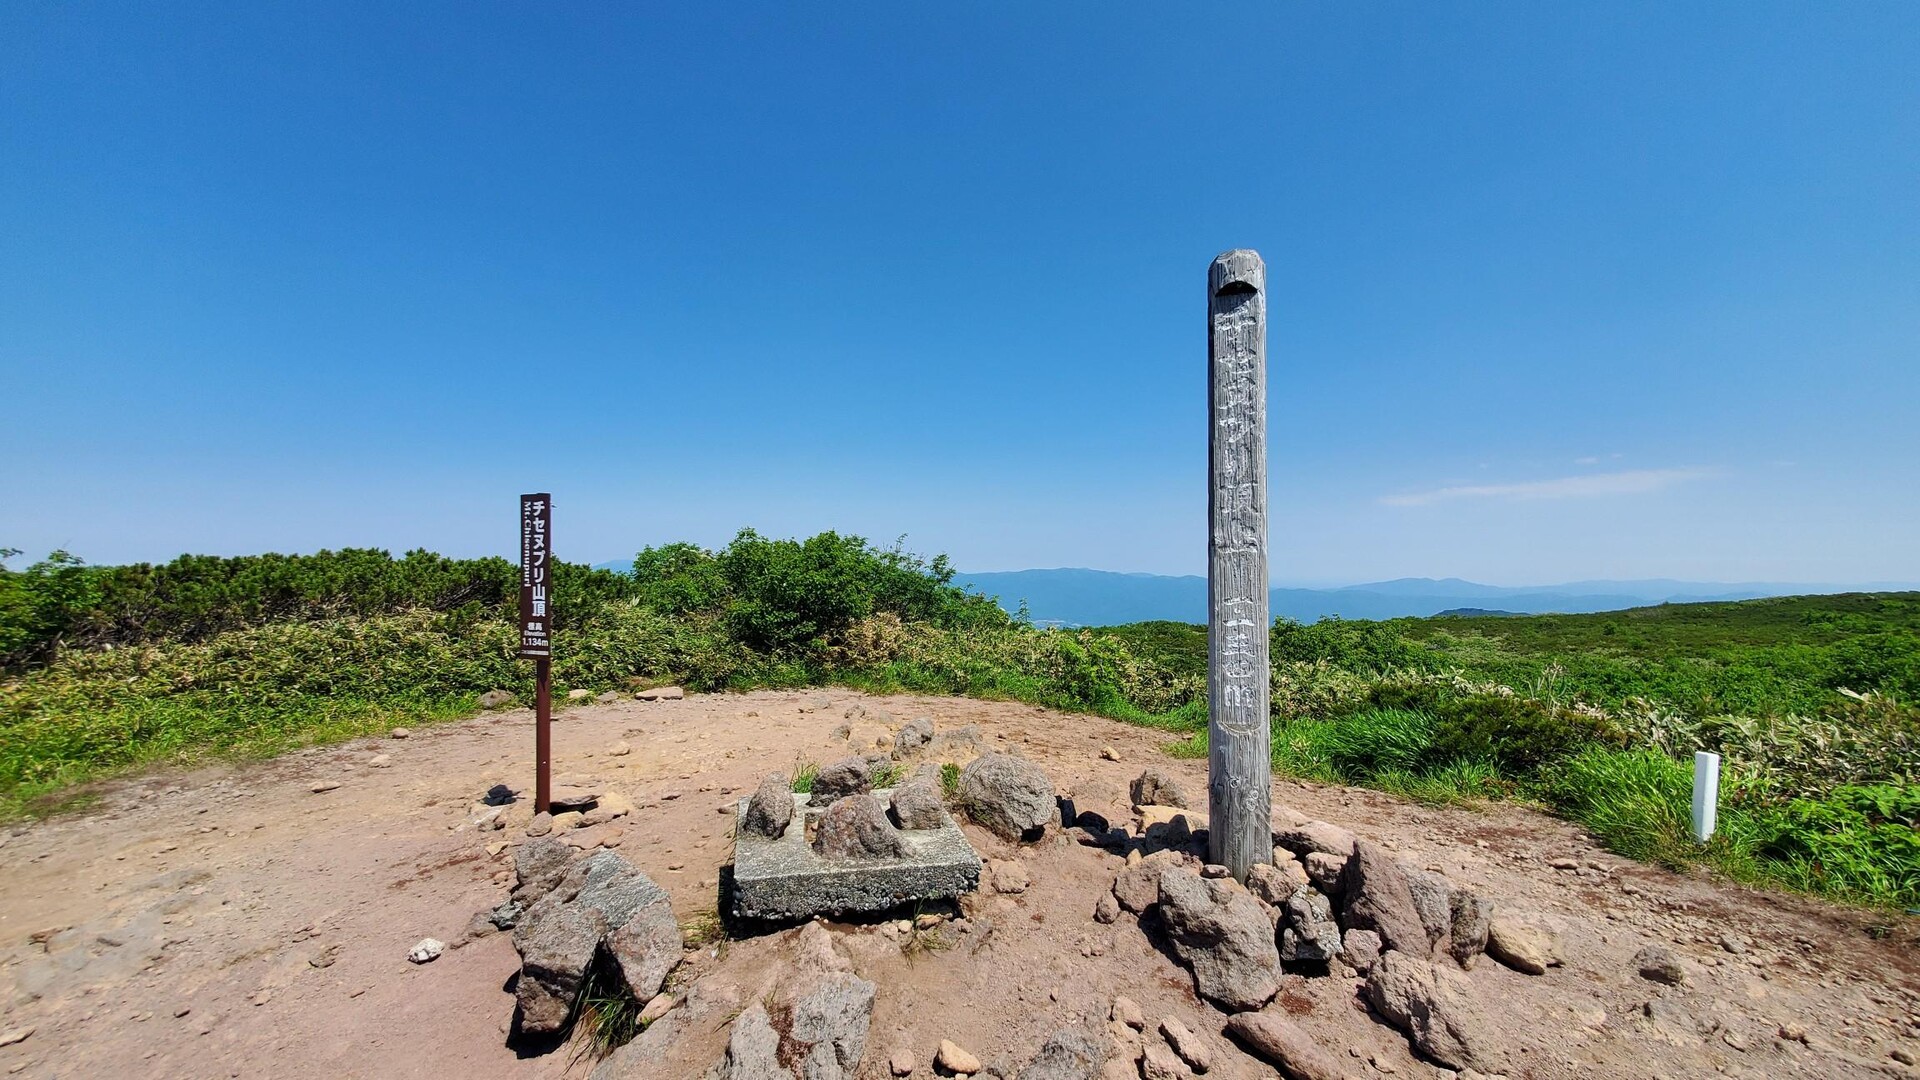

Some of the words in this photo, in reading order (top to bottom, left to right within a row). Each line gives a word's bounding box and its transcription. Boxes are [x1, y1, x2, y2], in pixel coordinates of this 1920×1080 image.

[532, 500, 546, 617] チセヌプリ山頂
